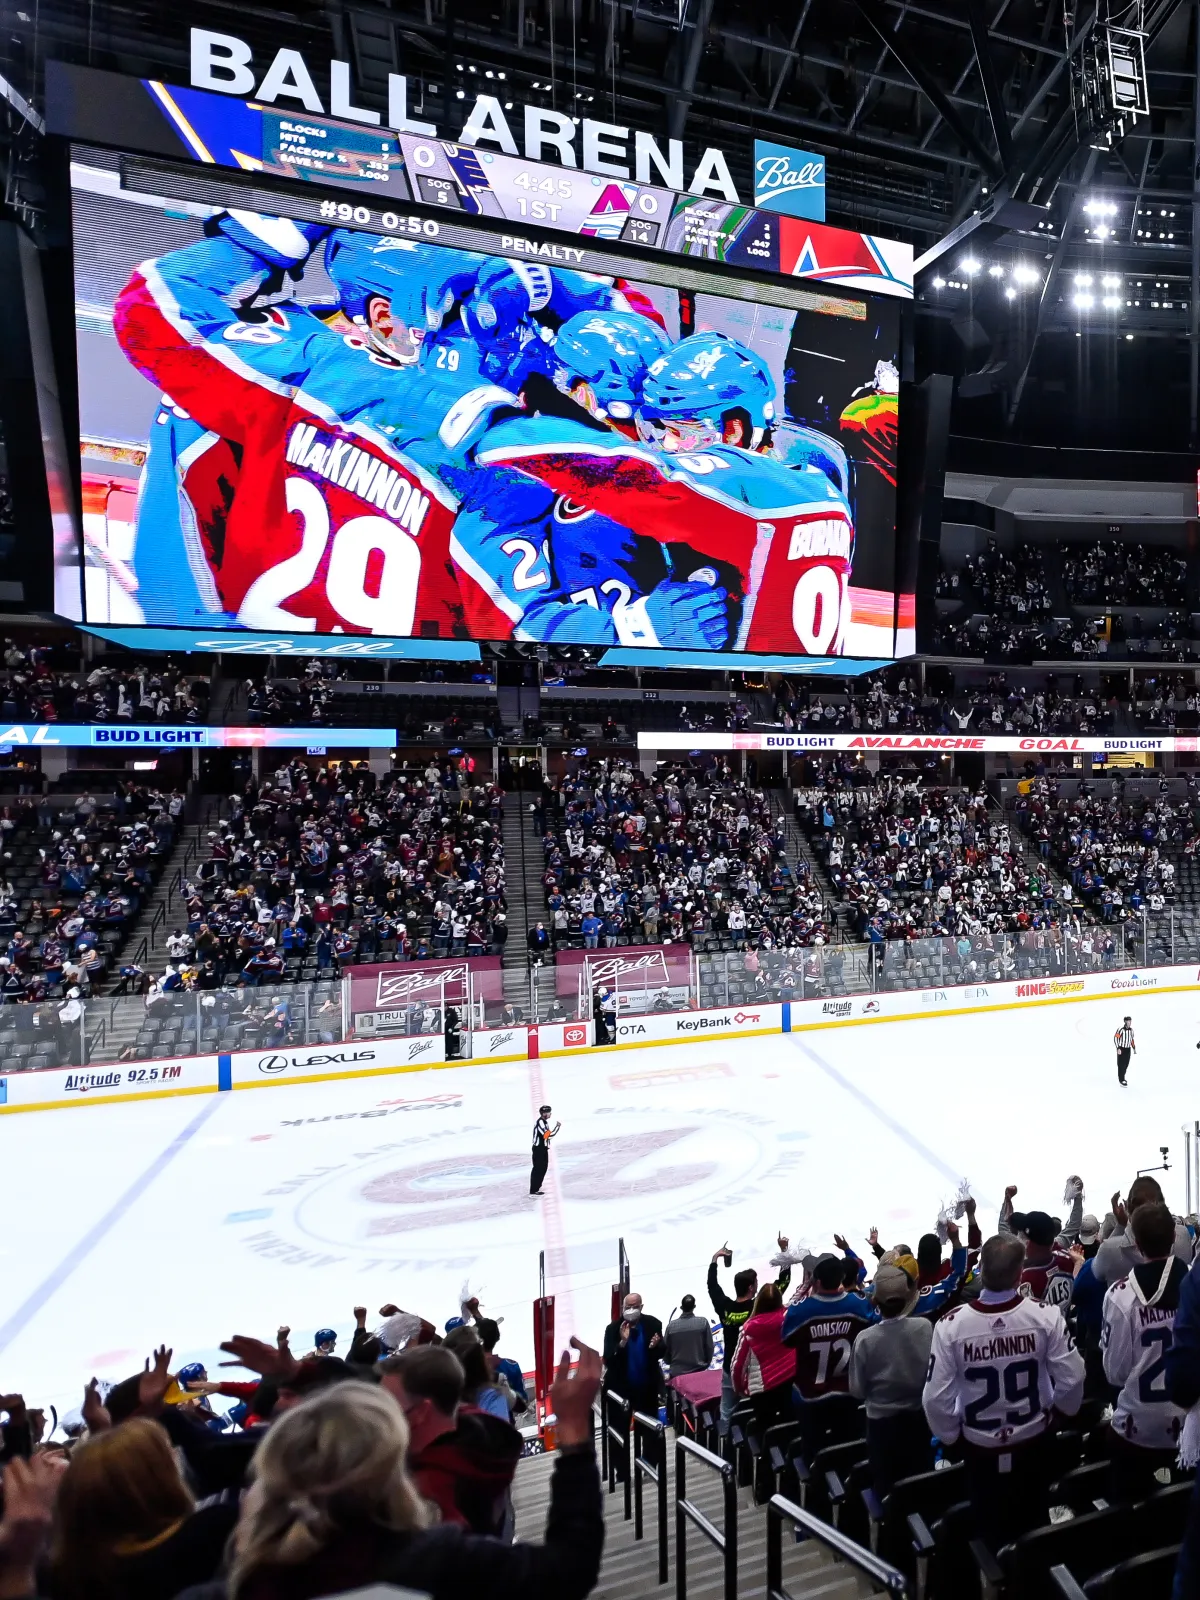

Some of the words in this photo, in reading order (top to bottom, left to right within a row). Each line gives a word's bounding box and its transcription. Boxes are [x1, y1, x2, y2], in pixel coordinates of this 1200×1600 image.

[191, 27, 437, 137] BALL
[458, 94, 741, 204] ARENA
[280, 121, 327, 139] BLOCKS
[280, 132, 307, 145] HITS
[413, 145, 436, 168] 0
[358, 168, 390, 183] 1.000
[756, 156, 825, 189] Ball
[427, 178, 452, 191] SOG
[513, 171, 573, 200] 4:45
[437, 191, 448, 204] 5
[639, 194, 658, 215] 0
[320, 200, 371, 225] #90
[381, 213, 440, 237] 0:50
[517, 197, 563, 223] 1ST
[630, 219, 652, 231] SOG
[685, 216, 705, 227] HITS
[630, 229, 648, 243] 14
[501, 236, 586, 263] PENALTY
[746, 247, 771, 258] 1.000
[436, 345, 460, 372] 29
[236, 477, 422, 637] 29
[500, 538, 550, 592] 2
[96, 730, 140, 742] BUD
[144, 730, 204, 743] LIGHT
[767, 737, 794, 747] BUD
[797, 737, 835, 748] LIGHT
[847, 738, 986, 749] AVALANCHE
[1018, 739, 1085, 751] GOAL
[1104, 740, 1129, 749] BUD
[1130, 740, 1163, 749] LIGHT
[592, 954, 660, 978] Ball
[381, 966, 466, 998] Ball
[1017, 983, 1047, 997] KING
[1111, 978, 1134, 989] Coors
[1135, 978, 1157, 986] LIGHT
[822, 1002, 852, 1012] Altitude
[377, 1012, 405, 1021] TRUL
[677, 1016, 731, 1032] KeyBank
[409, 1040, 434, 1054] Ball
[490, 1032, 514, 1047] Ball
[292, 1050, 376, 1067] LEXUS
[65, 1071, 121, 1090] Altitude
[128, 1068, 159, 1082] 92.5
[162, 1066, 181, 1080] FM
[810, 1320, 852, 1338] DONSKOI
[809, 1339, 852, 1386] 72
[1139, 1327, 1174, 1403] 2
[963, 1358, 1041, 1432] 29
